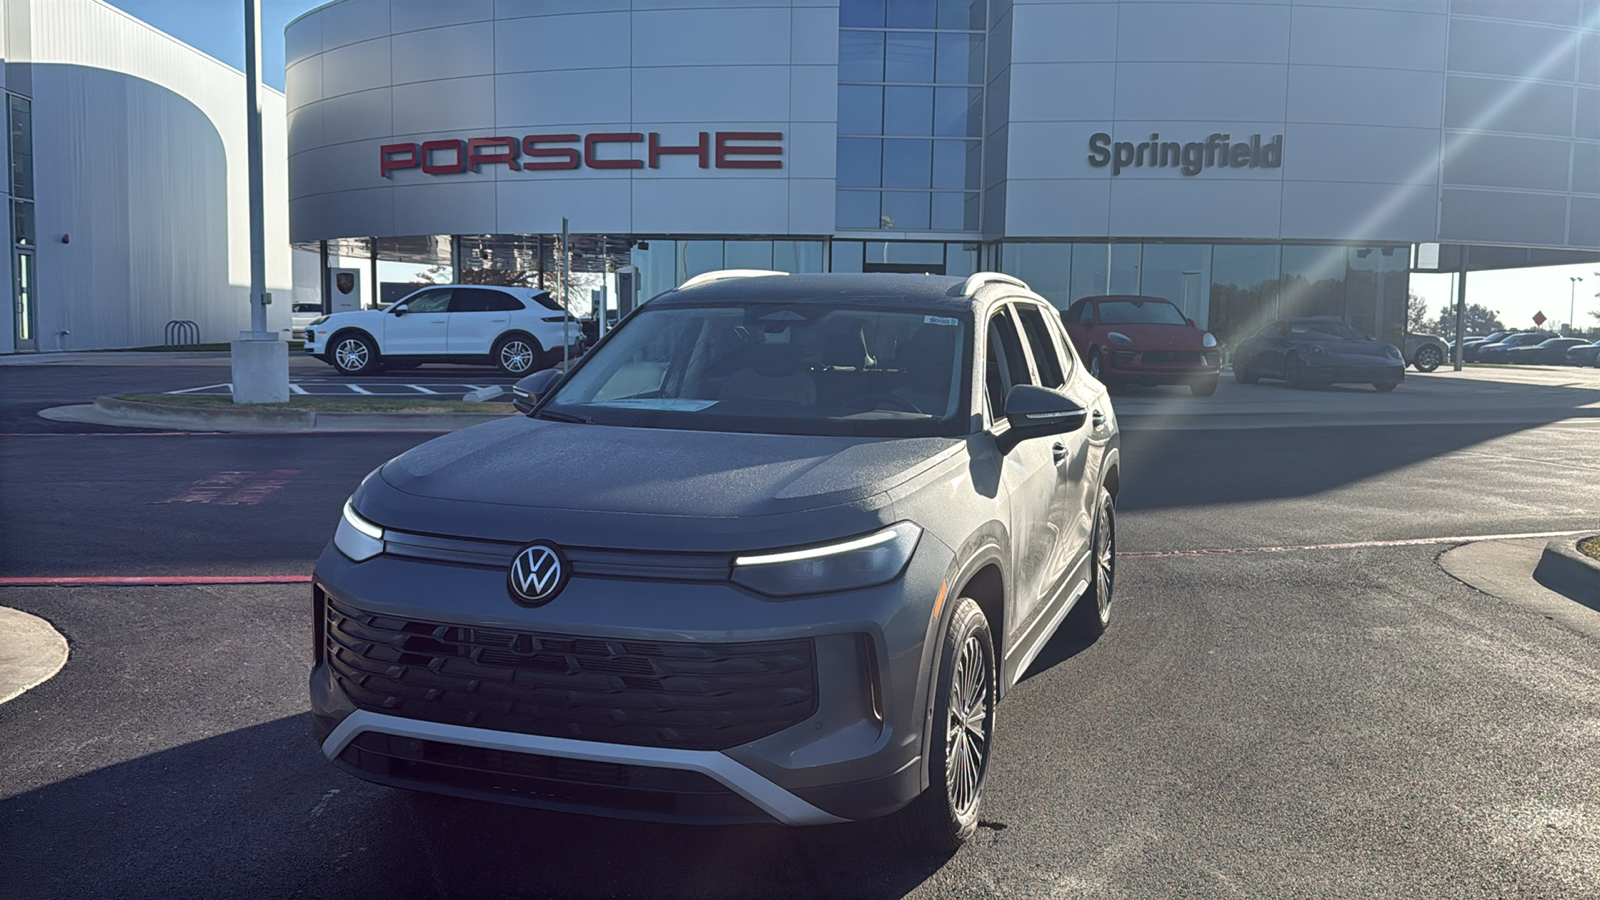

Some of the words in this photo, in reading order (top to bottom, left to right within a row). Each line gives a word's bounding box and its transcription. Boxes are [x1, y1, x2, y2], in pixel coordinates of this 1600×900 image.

[380, 132, 783, 178] PORSCHE
[1089, 133, 1283, 176] Springfield
[511, 545, 560, 599] VW
